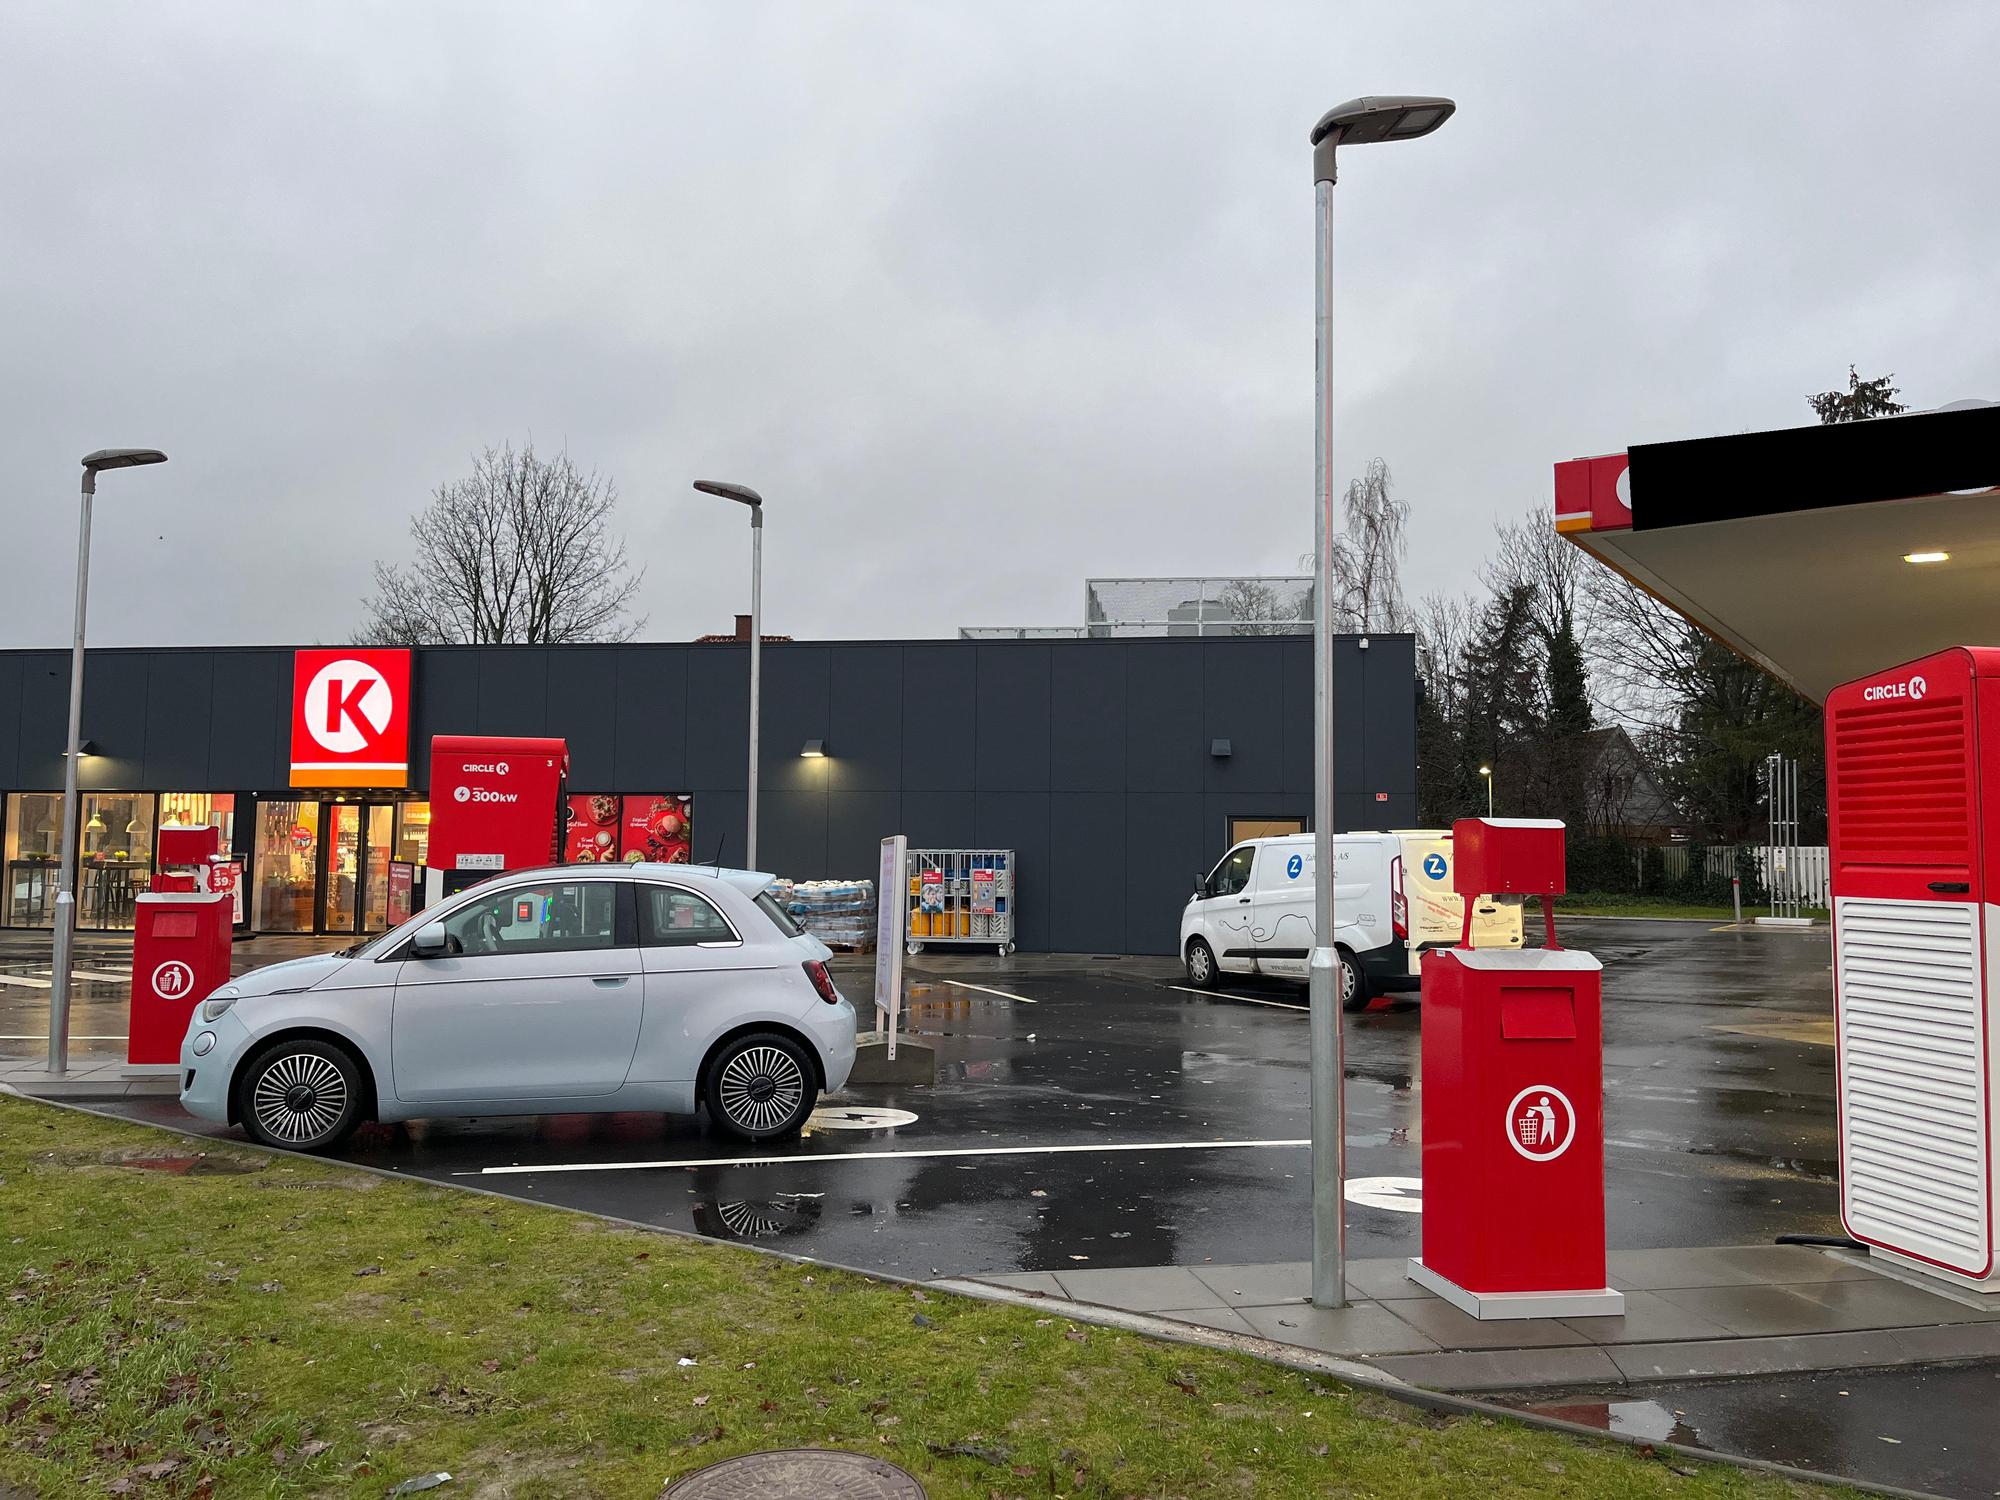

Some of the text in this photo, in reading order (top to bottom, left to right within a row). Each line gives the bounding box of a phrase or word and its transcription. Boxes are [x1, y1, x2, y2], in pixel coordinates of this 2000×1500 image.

[1864, 678, 1925, 701] CIRCLE K
[462, 763, 509, 775] CIRCLE K
[472, 791, 518, 802] 300kW
